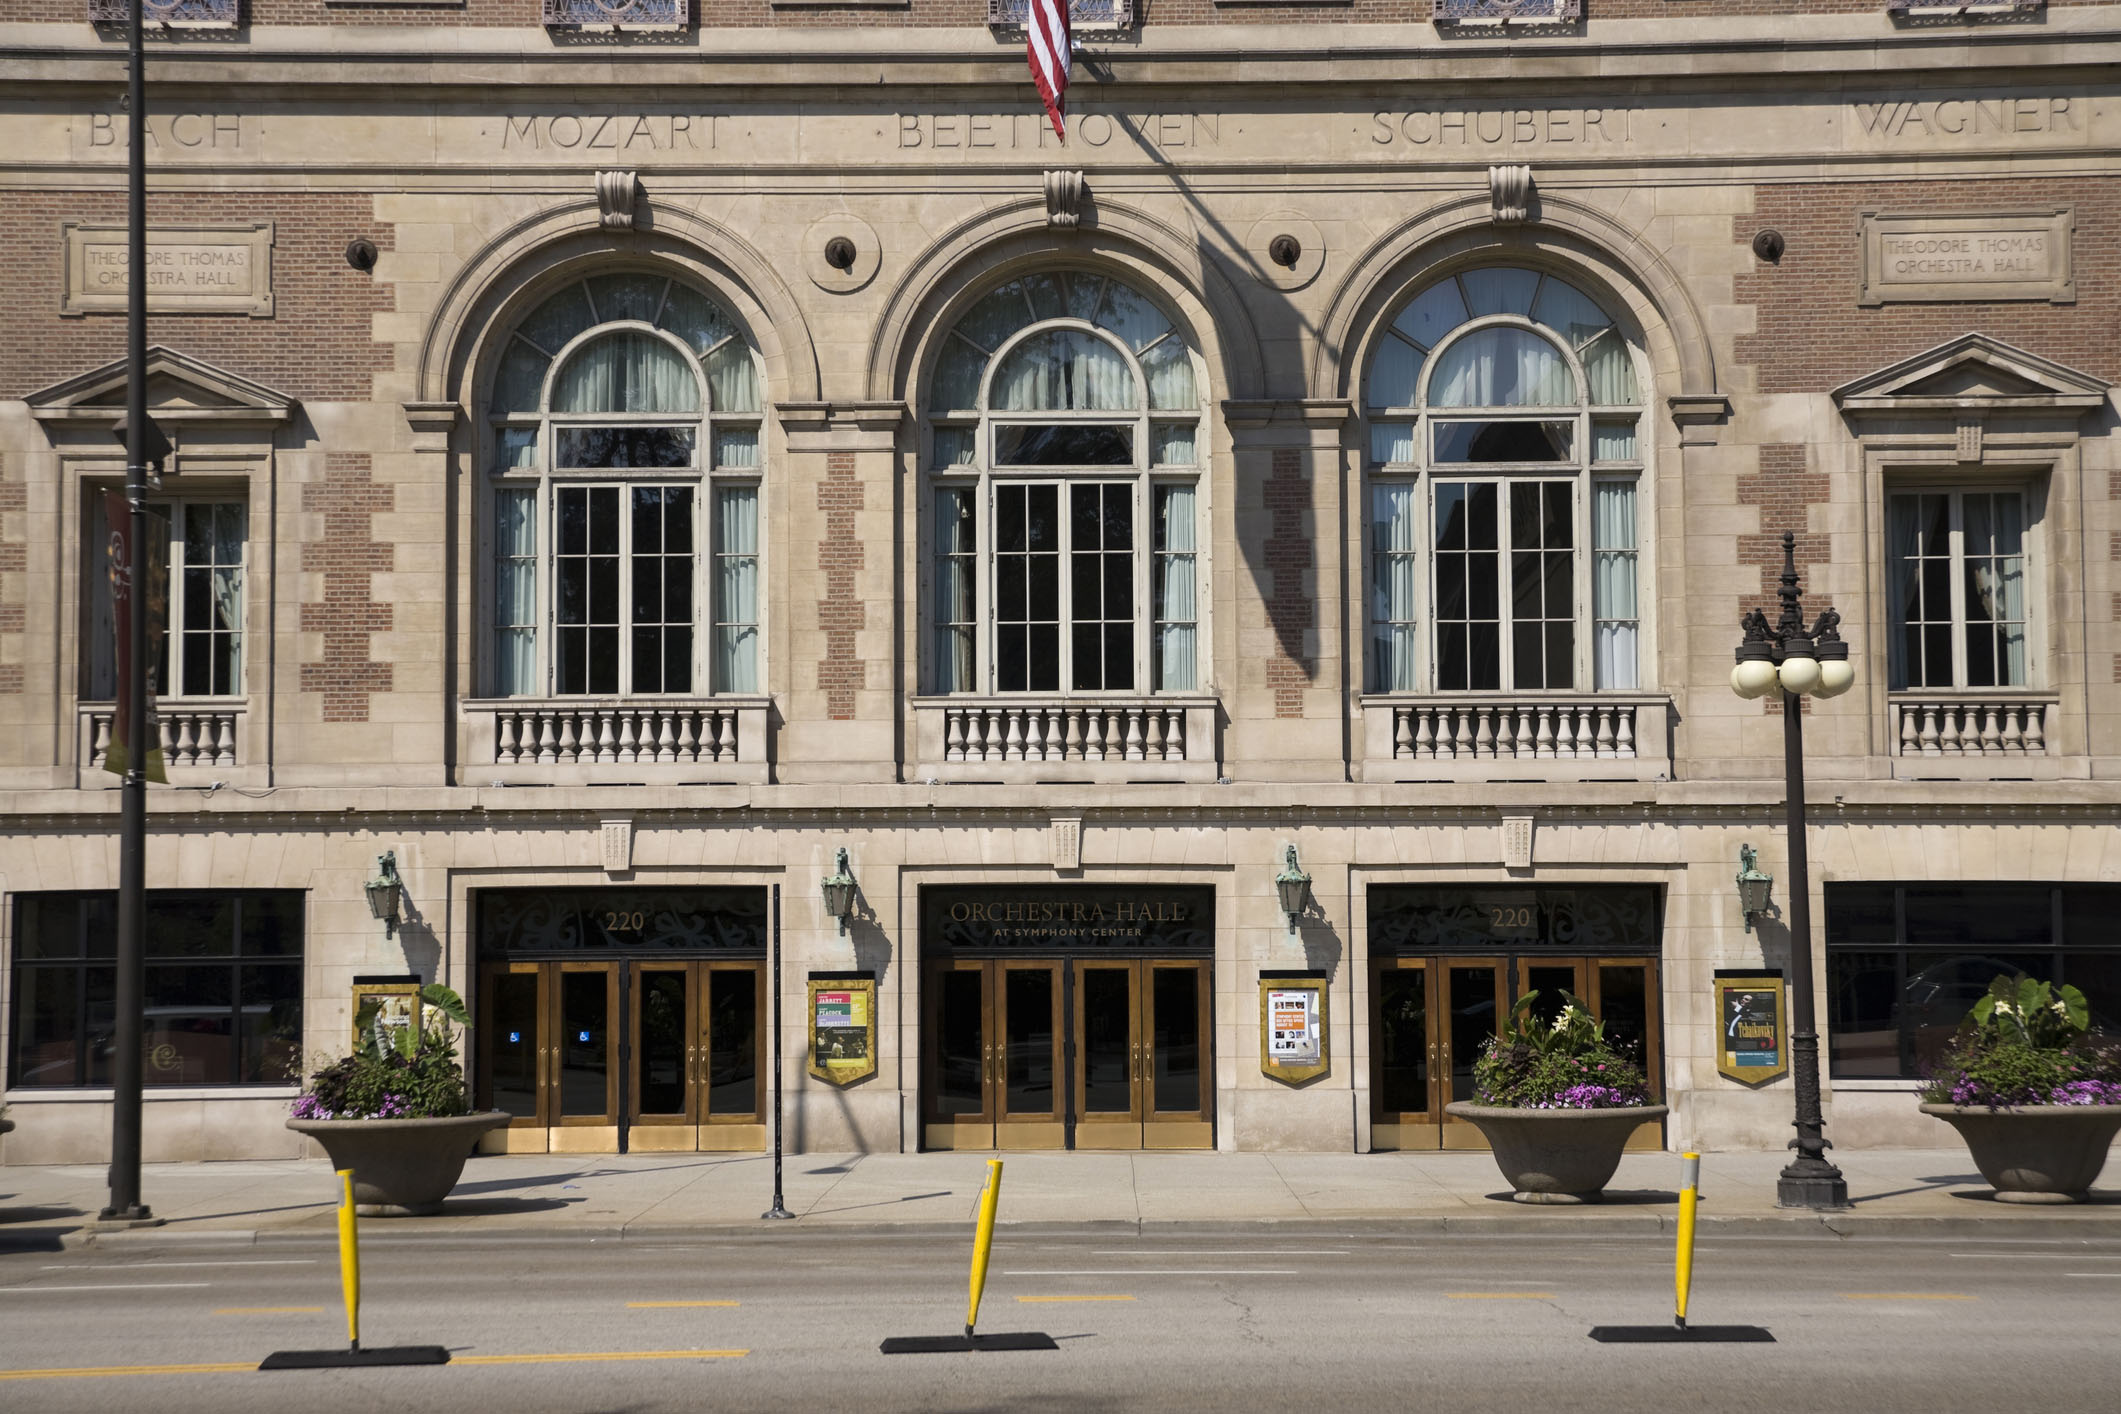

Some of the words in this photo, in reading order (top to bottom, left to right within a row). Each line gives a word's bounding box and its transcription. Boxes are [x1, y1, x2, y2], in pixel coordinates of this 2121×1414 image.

[1371, 108, 1646, 145] SCHUBERT
[1853, 97, 2081, 137] WAGNER
[501, 112, 731, 149] MOZART
[897, 112, 1221, 149] BEETHOVEN
[1887, 239, 1970, 254] THEODORE
[1977, 238, 2044, 252] THOMAS
[90, 251, 173, 266] THEOORE
[180, 251, 245, 266] THOMAS
[1895, 259, 1986, 274] ORCHESTRA
[1993, 258, 2036, 273] HALL
[98, 271, 186, 286] ORCSTRA
[195, 271, 237, 286] HALL
[605, 911, 645, 931] 220
[951, 902, 1107, 922] ORCHESTRA
[1116, 902, 1186, 922] HALL
[1491, 908, 1531, 928] 220
[993, 928, 1010, 937] AT
[1015, 928, 1086, 937] SYMPHONY
[1092, 928, 1143, 937] CENTER
